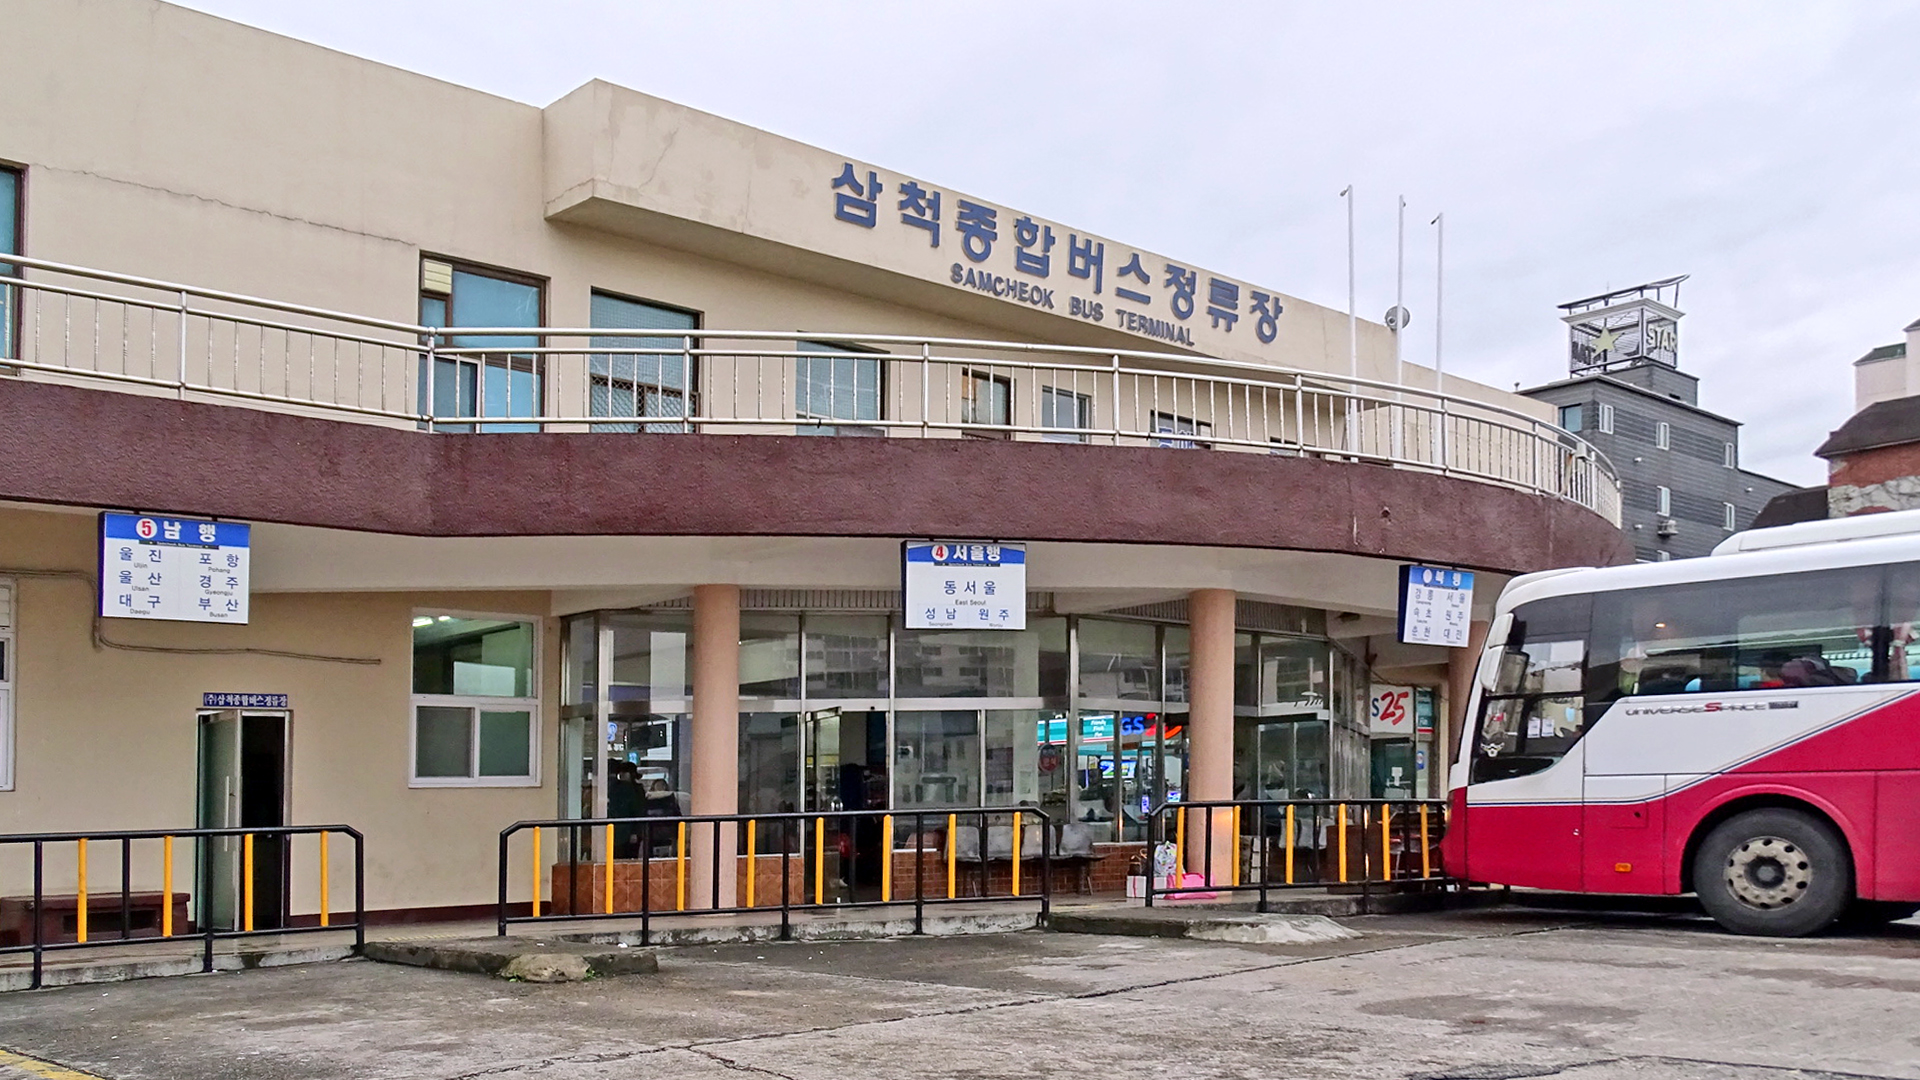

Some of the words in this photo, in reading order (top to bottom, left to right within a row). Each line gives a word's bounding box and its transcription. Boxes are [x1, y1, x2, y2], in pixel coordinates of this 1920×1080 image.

[831, 162, 1283, 344] 삼척종합버스정류장
[950, 263, 1054, 310] SAMCHEOK
[1069, 297, 1104, 322] BUS
[1116, 308, 1195, 347] TERMINAL
[1647, 325, 1677, 353] STAR
[953, 545, 1001, 562] 서울행
[208, 566, 231, 574] Pohang
[204, 589, 233, 597] Gyeongju
[944, 580, 996, 595] 동서울
